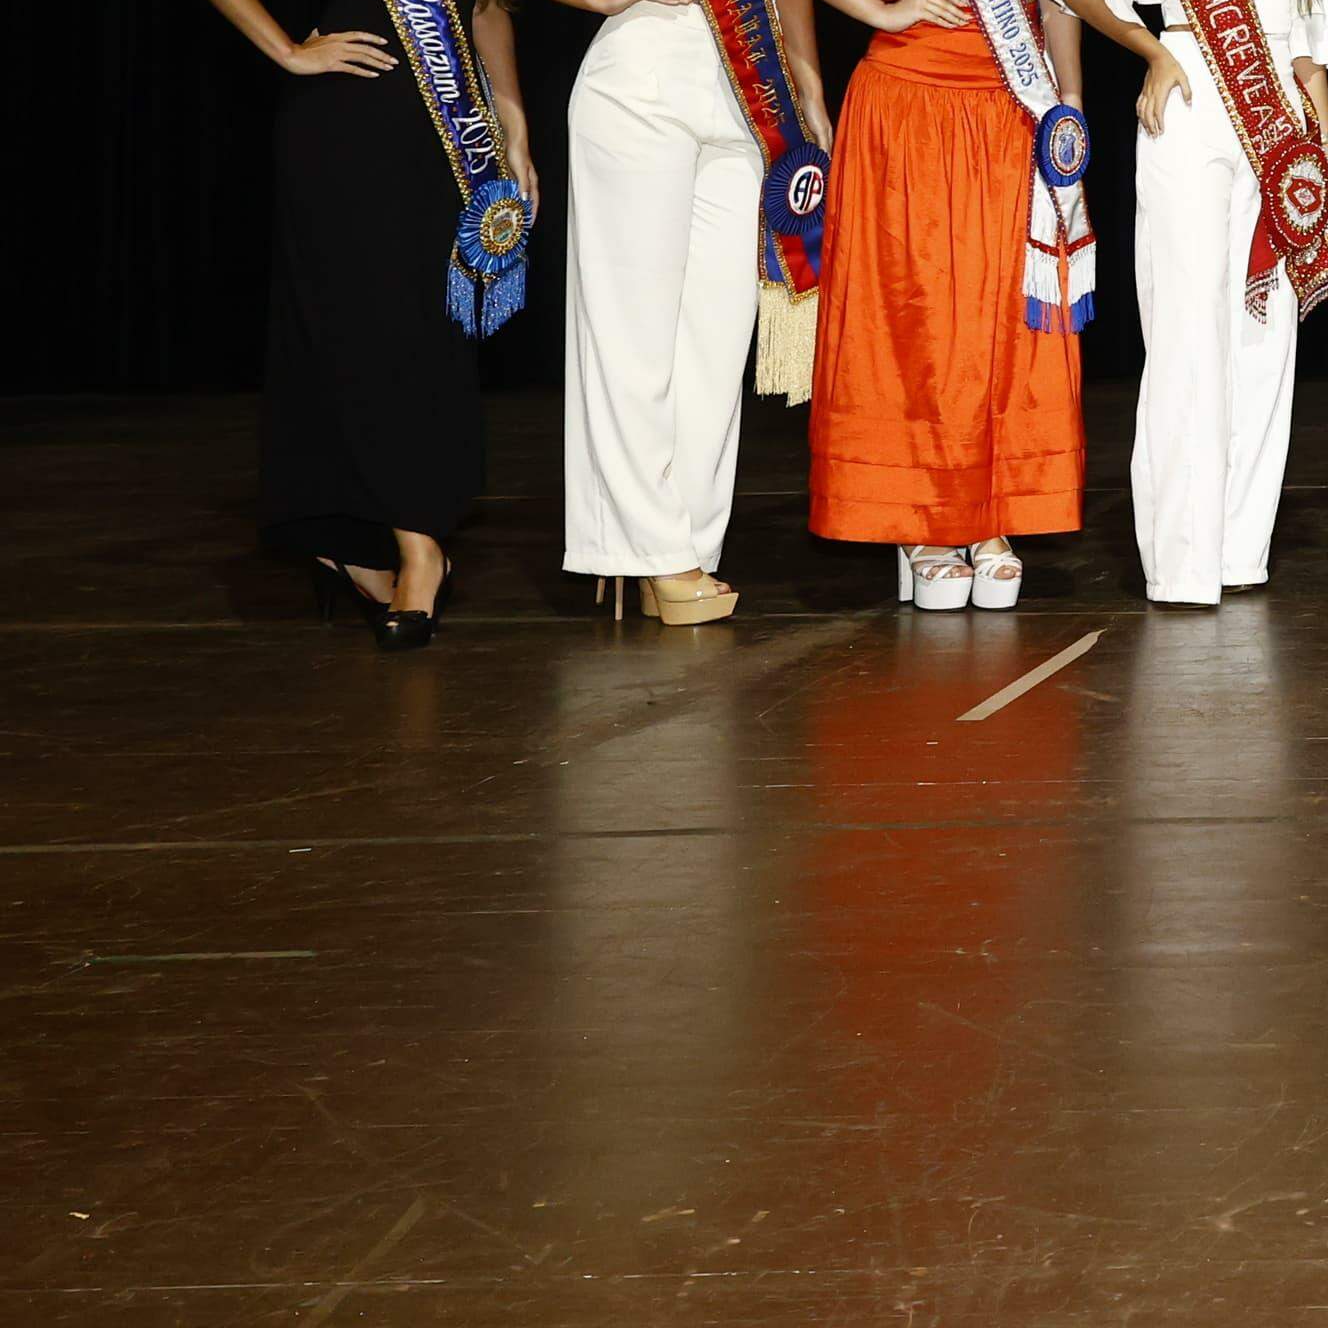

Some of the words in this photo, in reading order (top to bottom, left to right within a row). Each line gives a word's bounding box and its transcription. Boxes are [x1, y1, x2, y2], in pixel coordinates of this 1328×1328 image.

[1008, 42, 1039, 87] 2025
[451, 108, 495, 174] 2025
[1251, 115, 1293, 154] 2025
